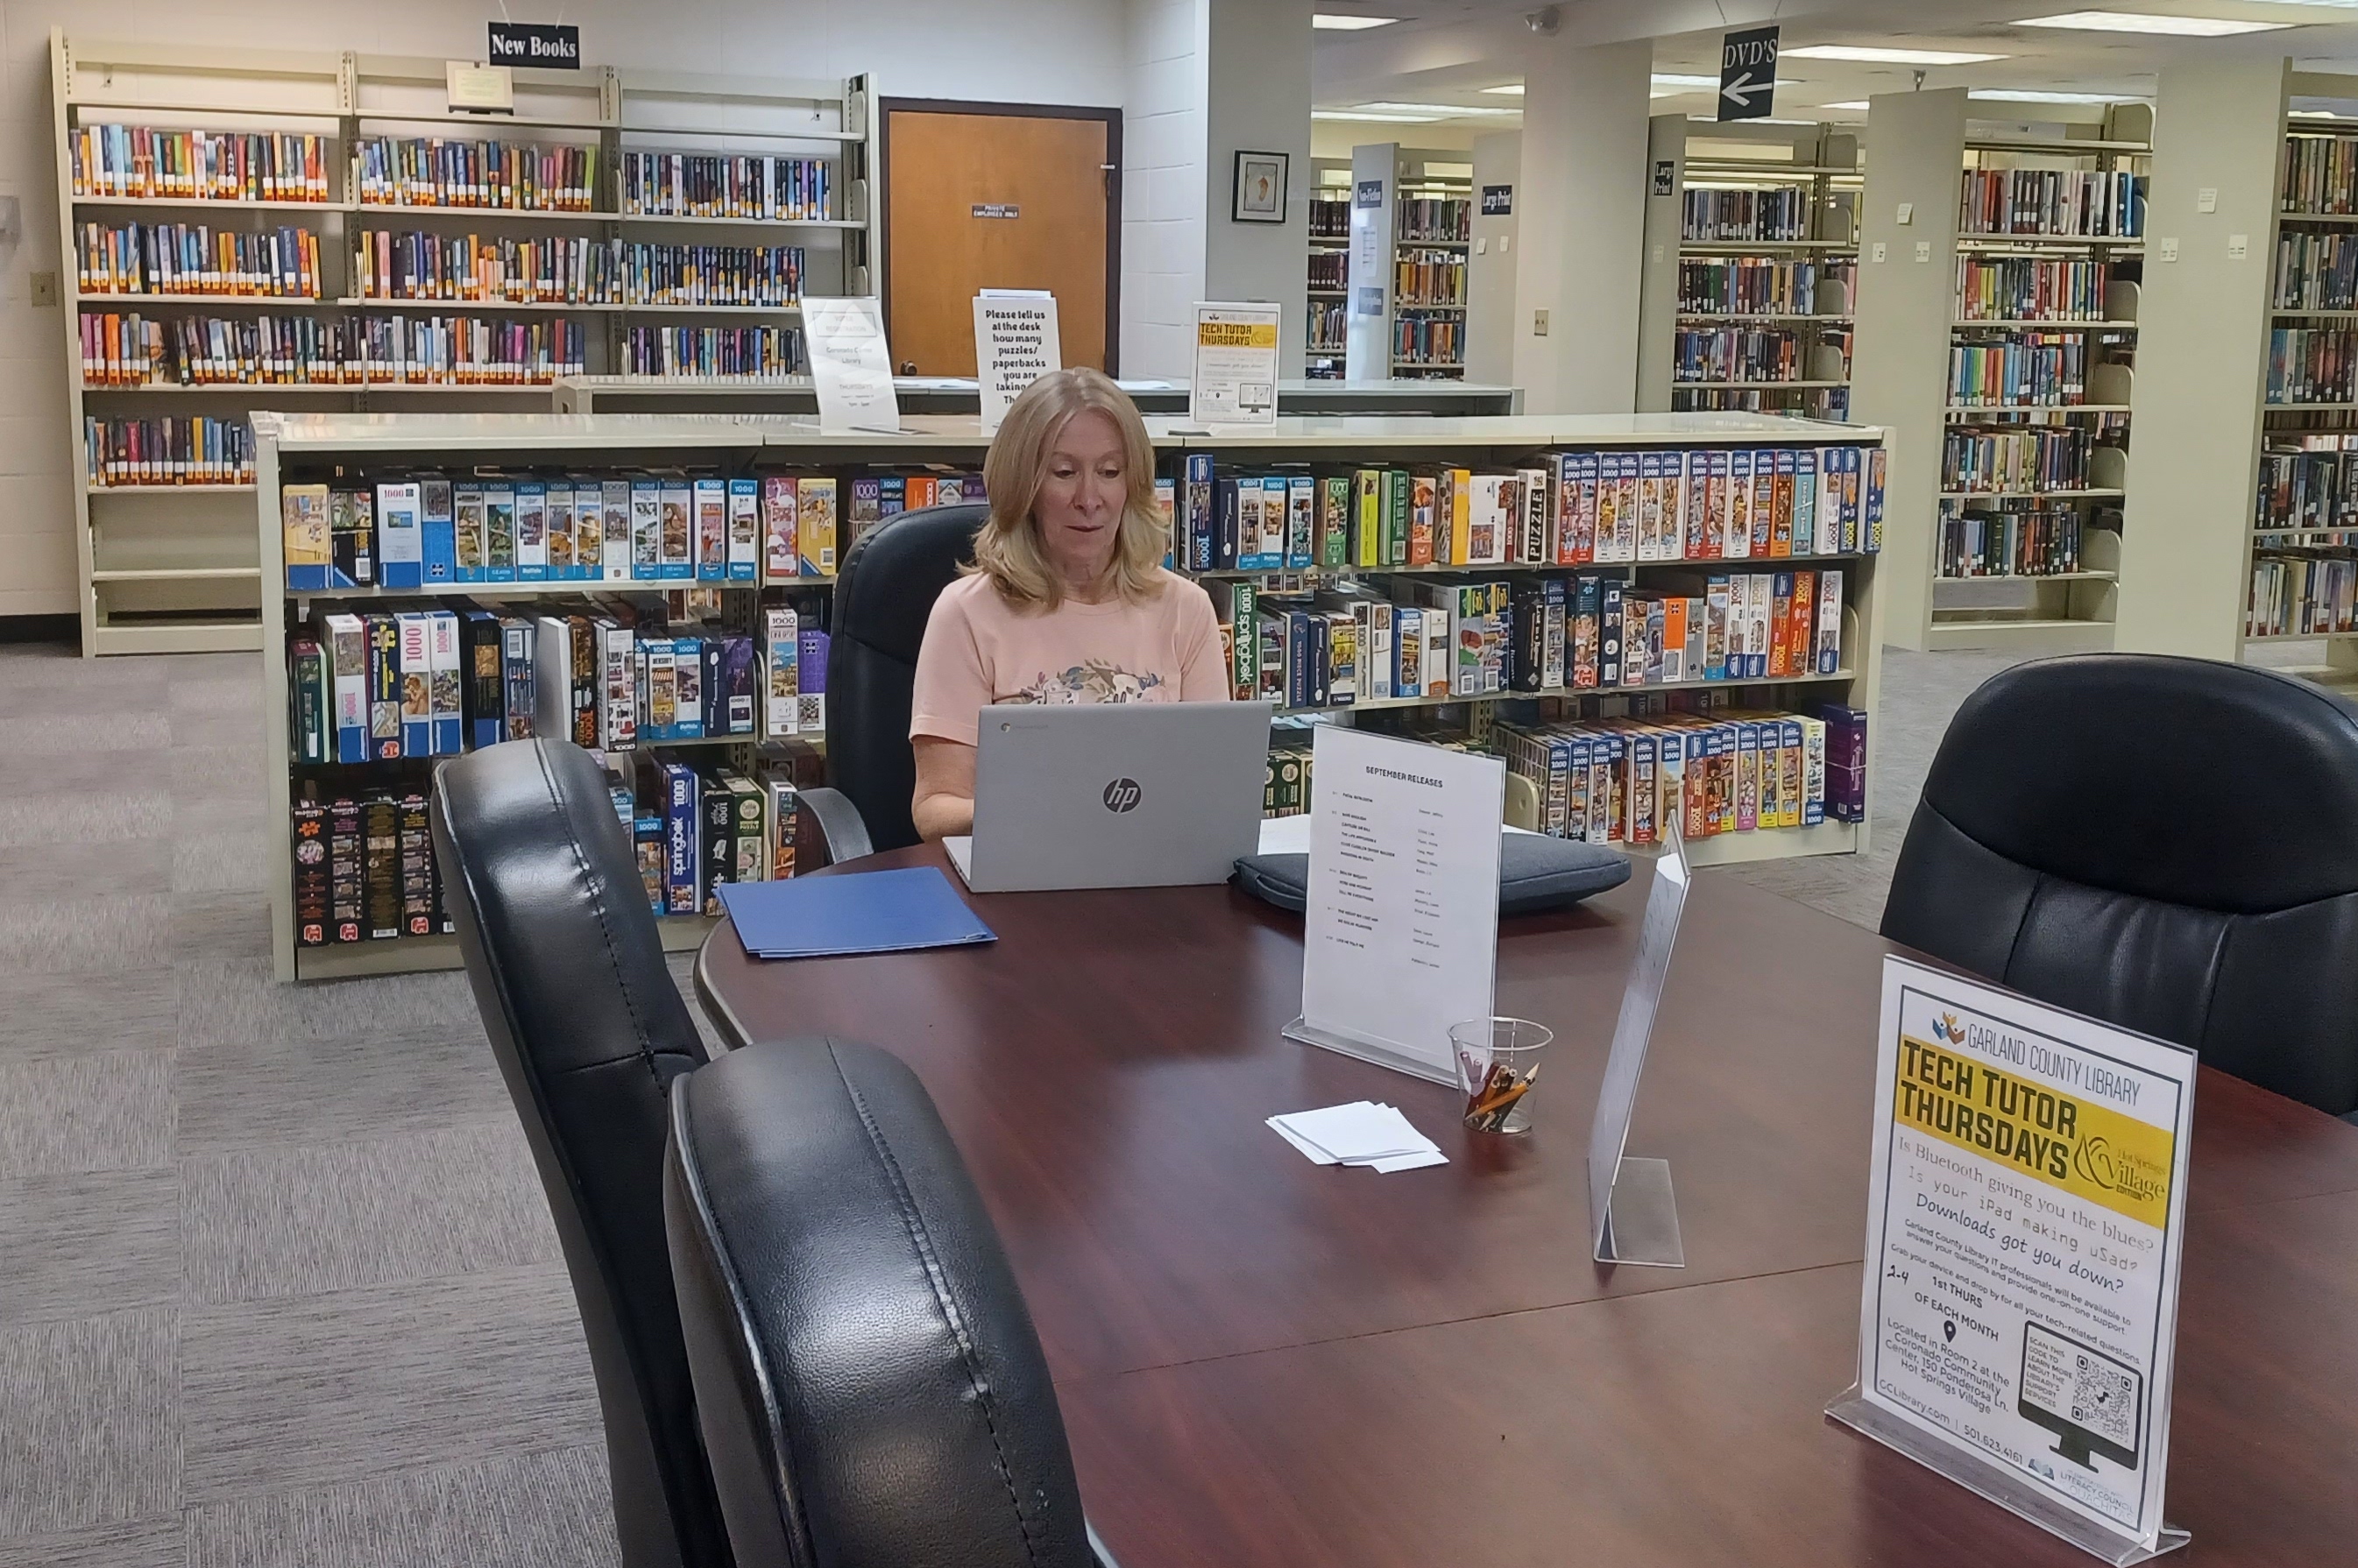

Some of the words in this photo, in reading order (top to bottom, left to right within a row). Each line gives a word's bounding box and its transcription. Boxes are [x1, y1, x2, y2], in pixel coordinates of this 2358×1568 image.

[492, 34, 526, 55] New
[530, 36, 576, 57] Books
[1724, 39, 1777, 69] DVD'S
[986, 310, 1016, 319] Please
[1018, 310, 1032, 319] tell
[1200, 323, 1221, 334] TECH
[1225, 324, 1251, 335] TUTOR
[999, 346, 1037, 357] puzzles/
[1200, 335, 1250, 345] THURSDAYS
[993, 358, 1045, 370] paperbacks
[1003, 372, 1021, 381] you
[384, 489, 404, 498] 1000
[1529, 492, 1542, 557] PUZZLE
[1196, 535, 1209, 562] 1000
[1242, 586, 1251, 613] 1000
[405, 627, 422, 661] 1000
[1236, 614, 1253, 682] springbok
[1357, 626, 1366, 646] 1000
[674, 780, 685, 807] 1000
[1366, 766, 1406, 780] SEPTEMBER
[1407, 773, 1443, 788] RELEASES
[1108, 778, 1138, 813] hp
[671, 816, 684, 876] springbok
[1969, 1023, 2025, 1065] GARLAND
[2030, 1046, 2081, 1084] COUNTY
[2085, 1065, 2141, 1106] LIBRARY
[1904, 1040, 1973, 1099] TECH
[1983, 1069, 2076, 1140] TUTOR
[1901, 1080, 2068, 1180] THURSDAYS
[2099, 1153, 2165, 1201] Village
[1899, 1137, 1910, 1152] Is
[1915, 1143, 1982, 1183] Bluetooth
[1988, 1177, 2032, 1208] giving
[2037, 1197, 2064, 1218] you
[2073, 1211, 2096, 1231] the
[2103, 1221, 2153, 1253] blues?
[1908, 1166, 1923, 1183] Is
[1934, 1181, 1968, 1199] your
[1979, 1196, 2012, 1221] iPad
[2023, 1218, 2078, 1252] making
[1916, 1193, 1996, 1239] Downloads
[2000, 1235, 2028, 1253] got
[2033, 1248, 2060, 1268] you
[2069, 1261, 2123, 1293] down?
[1887, 1265, 1908, 1285] 2-4
[1907, 1231, 1933, 1247] answer
[1935, 1243, 1951, 1254] your
[1955, 1252, 1989, 1273] questions
[1992, 1269, 2006, 1281] and
[2008, 1277, 2037, 1295] provide
[2040, 1292, 2090, 1318] one-on-one
[2093, 1315, 2127, 1336] support.
[1936, 1232, 1963, 1250] County
[1965, 1245, 1989, 1263] Library
[2000, 1263, 2052, 1290] professionals
[2055, 1287, 2069, 1298] will
[2071, 1293, 2082, 1303] be
[2085, 1300, 2120, 1320] available
[2123, 1316, 2131, 1325] to
[1891, 1244, 1908, 1256] Grab
[1910, 1254, 1927, 1264] your
[1929, 1261, 1953, 1276] device
[1956, 1273, 1969, 1284] and
[1972, 1281, 1988, 1294] drop
[1990, 1289, 1999, 1301] by
[2001, 1295, 2012, 1305] for
[2015, 1303, 2023, 1311] all
[2025, 1306, 2043, 1319] your
[2046, 1316, 2097, 1344] tech-related
[1933, 1276, 1947, 1291] 1st
[1950, 1283, 1982, 1309] THURS
[1915, 1292, 1929, 1305] OF
[1931, 1300, 1958, 1321] EACH
[1961, 1315, 1999, 1341] MONTH
[1887, 1317, 1926, 1344] Located
[1930, 1337, 1937, 1349] in
[1941, 1344, 1969, 1366] Room
[1972, 1360, 1978, 1370] 2
[1980, 1367, 1989, 1377] at
[1993, 1371, 2009, 1388] the
[2029, 1337, 2048, 1350] SCAN
[2029, 1346, 2047, 1359] CODE
[1894, 1332, 1941, 1362] Coronado
[1944, 1358, 2000, 1395] Community
[2028, 1363, 2050, 1377] ABOUT
[2052, 1366, 2072, 1379] MORE
[1901, 1359, 1917, 1374] Hot
[1921, 1368, 1956, 1395] Springs
[1959, 1389, 1991, 1414] Village
[1923, 1358, 1937, 1372] 150
[1940, 1367, 1991, 1402] Ponderosa
[1994, 1395, 2008, 1412] Ln.
[1880, 1380, 1950, 1423] GCLibrary.com
[1965, 1425, 2022, 1465] 501.623.4161
